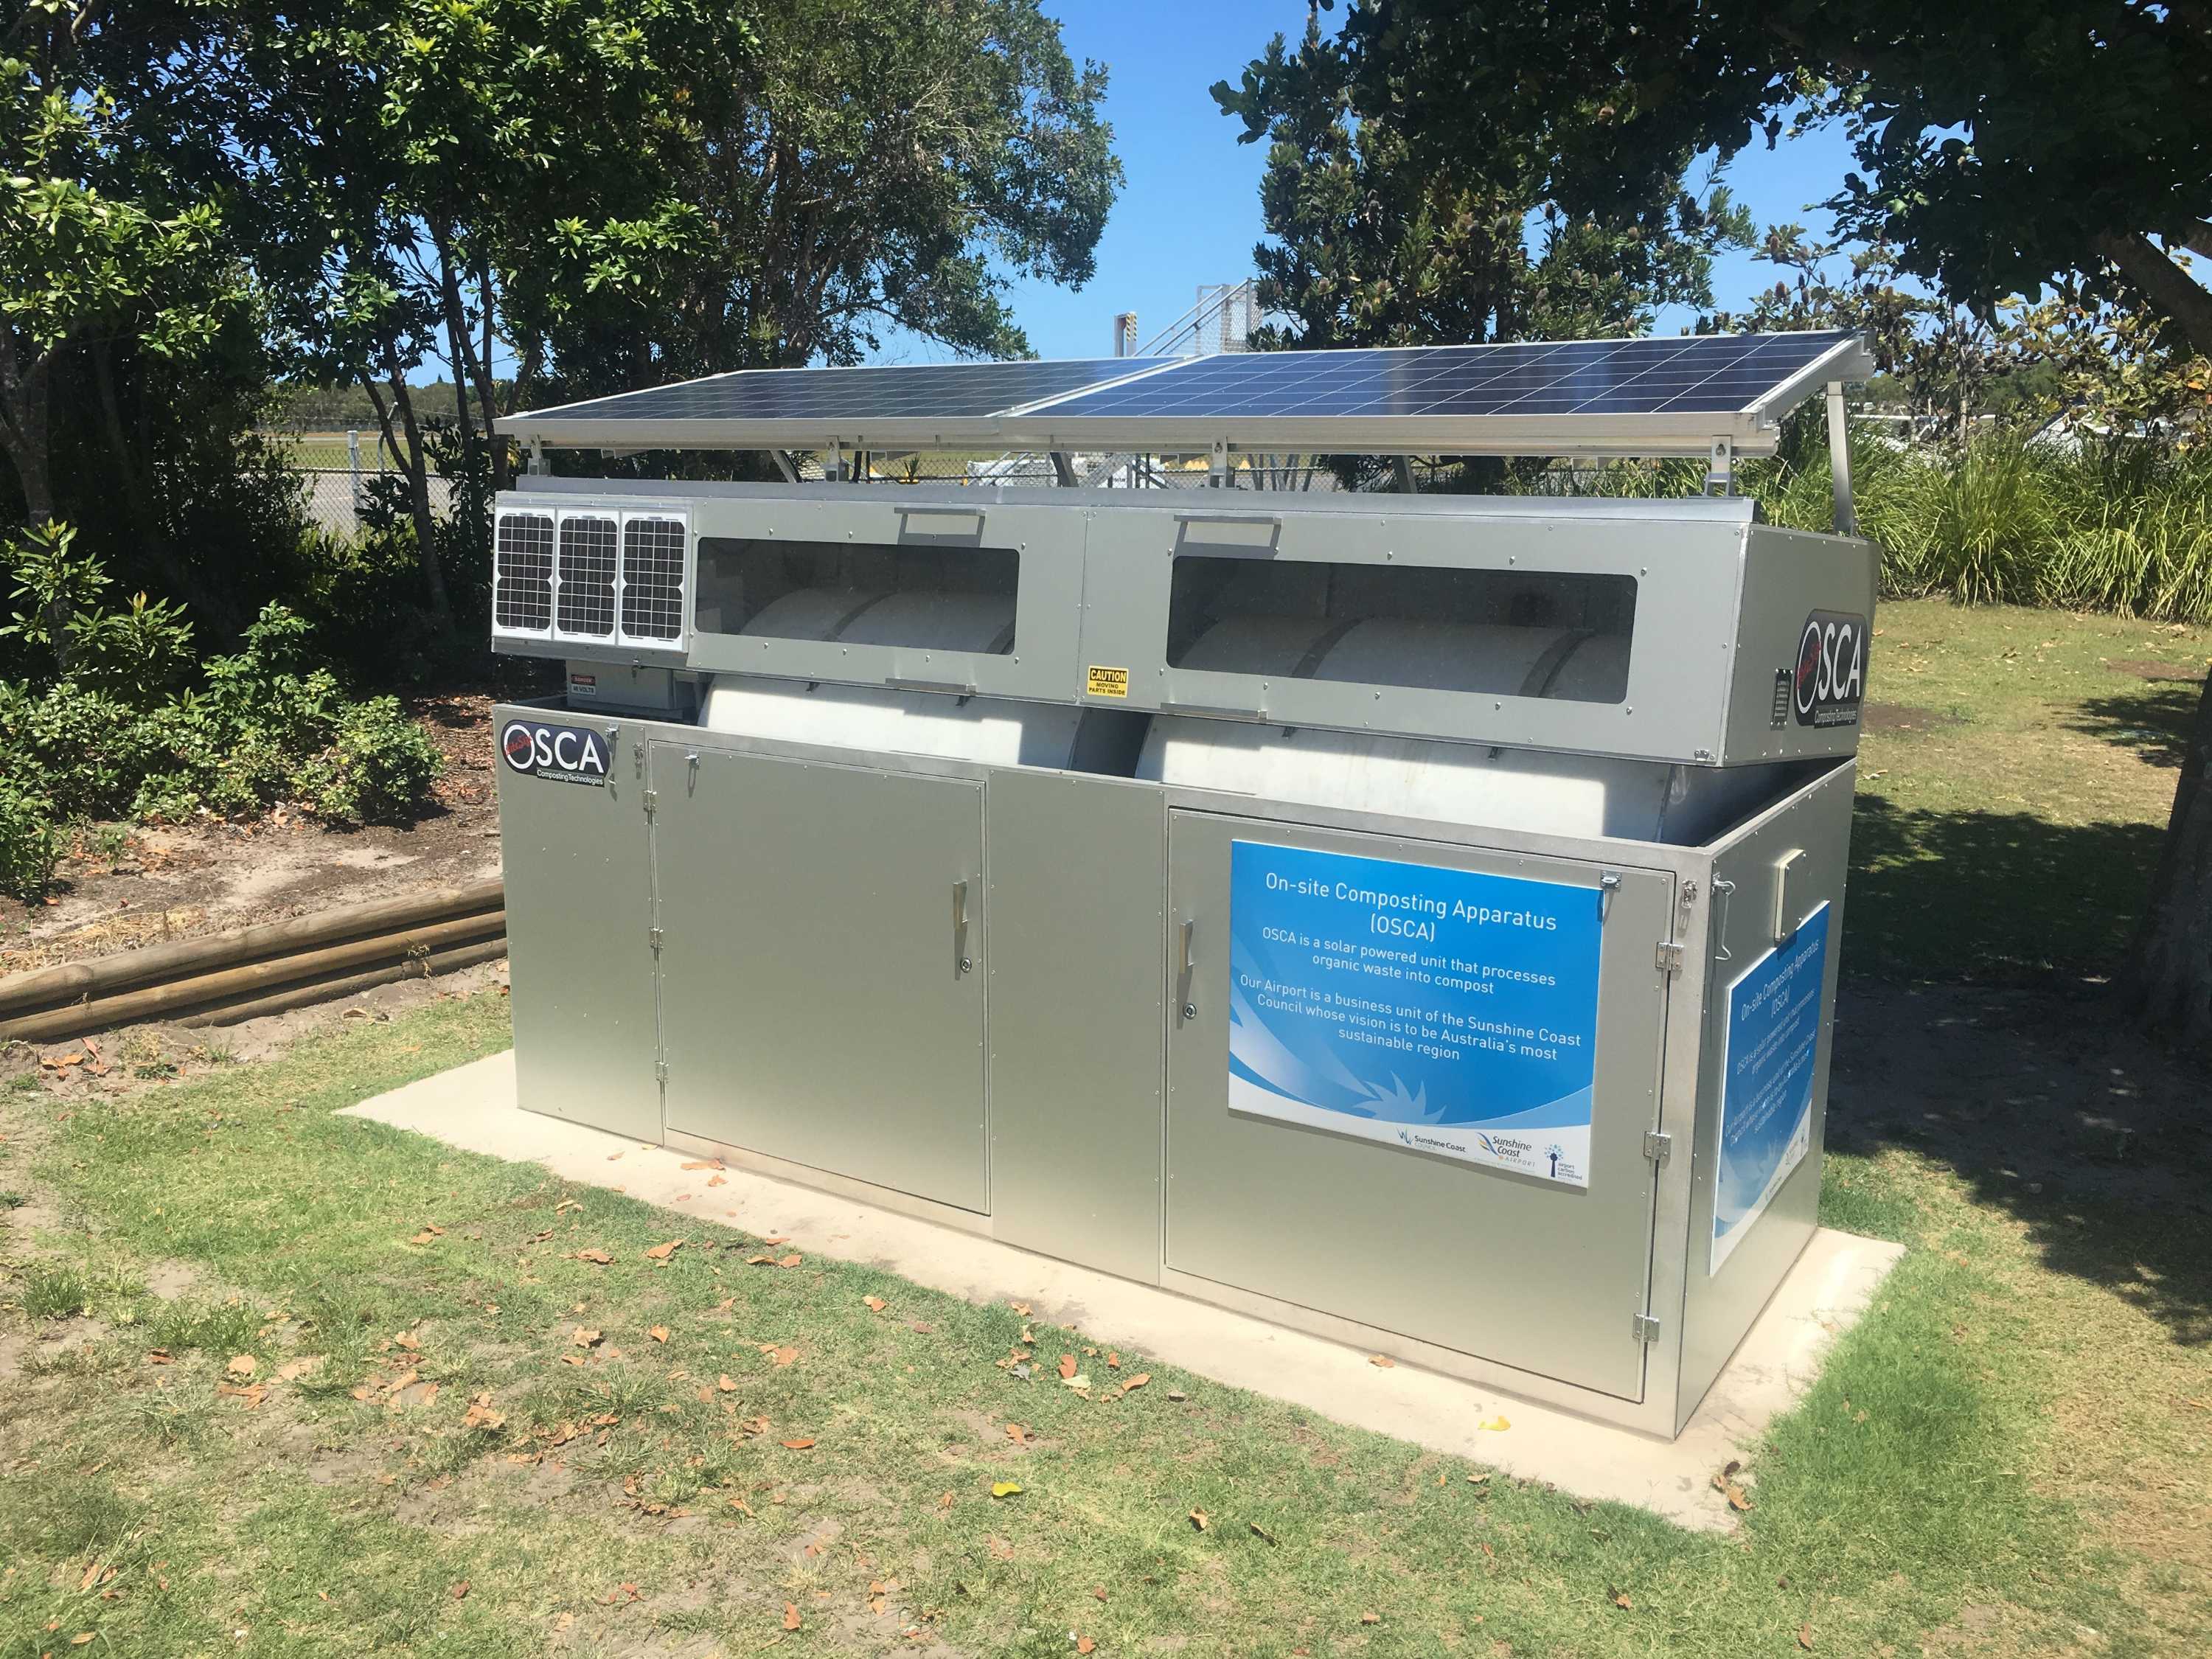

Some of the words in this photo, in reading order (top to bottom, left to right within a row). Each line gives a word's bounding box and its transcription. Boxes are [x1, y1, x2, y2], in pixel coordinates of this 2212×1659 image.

[1091, 669, 1127, 682] CAUTION
[1796, 621, 1860, 714] OSCA
[504, 724, 605, 773] OSCA
[1266, 872, 1329, 897] On-site
[1335, 882, 1447, 919] Composting
[1452, 899, 1557, 931] Apparatus
[1371, 913, 1435, 942] (OSCA)
[1262, 926, 1296, 945] OSCA
[1299, 933, 1310, 947] is
[1312, 939, 1320, 948] a
[1324, 937, 1357, 954] solar
[1360, 946, 1416, 964] powered
[1421, 955, 1447, 969] unit
[1451, 958, 1478, 974] that
[1482, 965, 1556, 986] processes
[1312, 955, 1360, 972] organic
[1363, 963, 1402, 978] waste
[1405, 967, 1430, 984] into
[1435, 975, 1494, 994] compost
[1240, 974, 1262, 989] Our
[1264, 979, 1307, 998] Airport
[1310, 987, 1321, 1001] is
[1324, 993, 1331, 1003] a
[1335, 992, 1392, 1014] business
[1396, 1006, 1422, 1020] unit
[1425, 1010, 1439, 1021] of
[1442, 1012, 1464, 1027] the
[1468, 1016, 1534, 1039] Sunshine
[1539, 1028, 1582, 1047] Coast
[1742, 992, 1762, 1021] On-site
[1763, 963, 1795, 1000] Composting
[1257, 994, 1303, 1014] Council
[1306, 1005, 1346, 1022] whose
[1349, 1013, 1386, 1029] vision
[1391, 1019, 1401, 1032] is
[1405, 1023, 1417, 1035] to
[1422, 1026, 1437, 1039] be
[1441, 1029, 1516, 1054] Australia's
[1520, 1044, 1557, 1060] most
[1338, 1029, 1413, 1051] sustainable
[1417, 1044, 1460, 1060] region
[1414, 1135, 1444, 1147] Sunshine
[1446, 1143, 1466, 1152] Coast
[1492, 1135, 1532, 1151] Sunshine
[1498, 1146, 1520, 1158] Coast
[1505, 1156, 1535, 1167] AIRPORT
